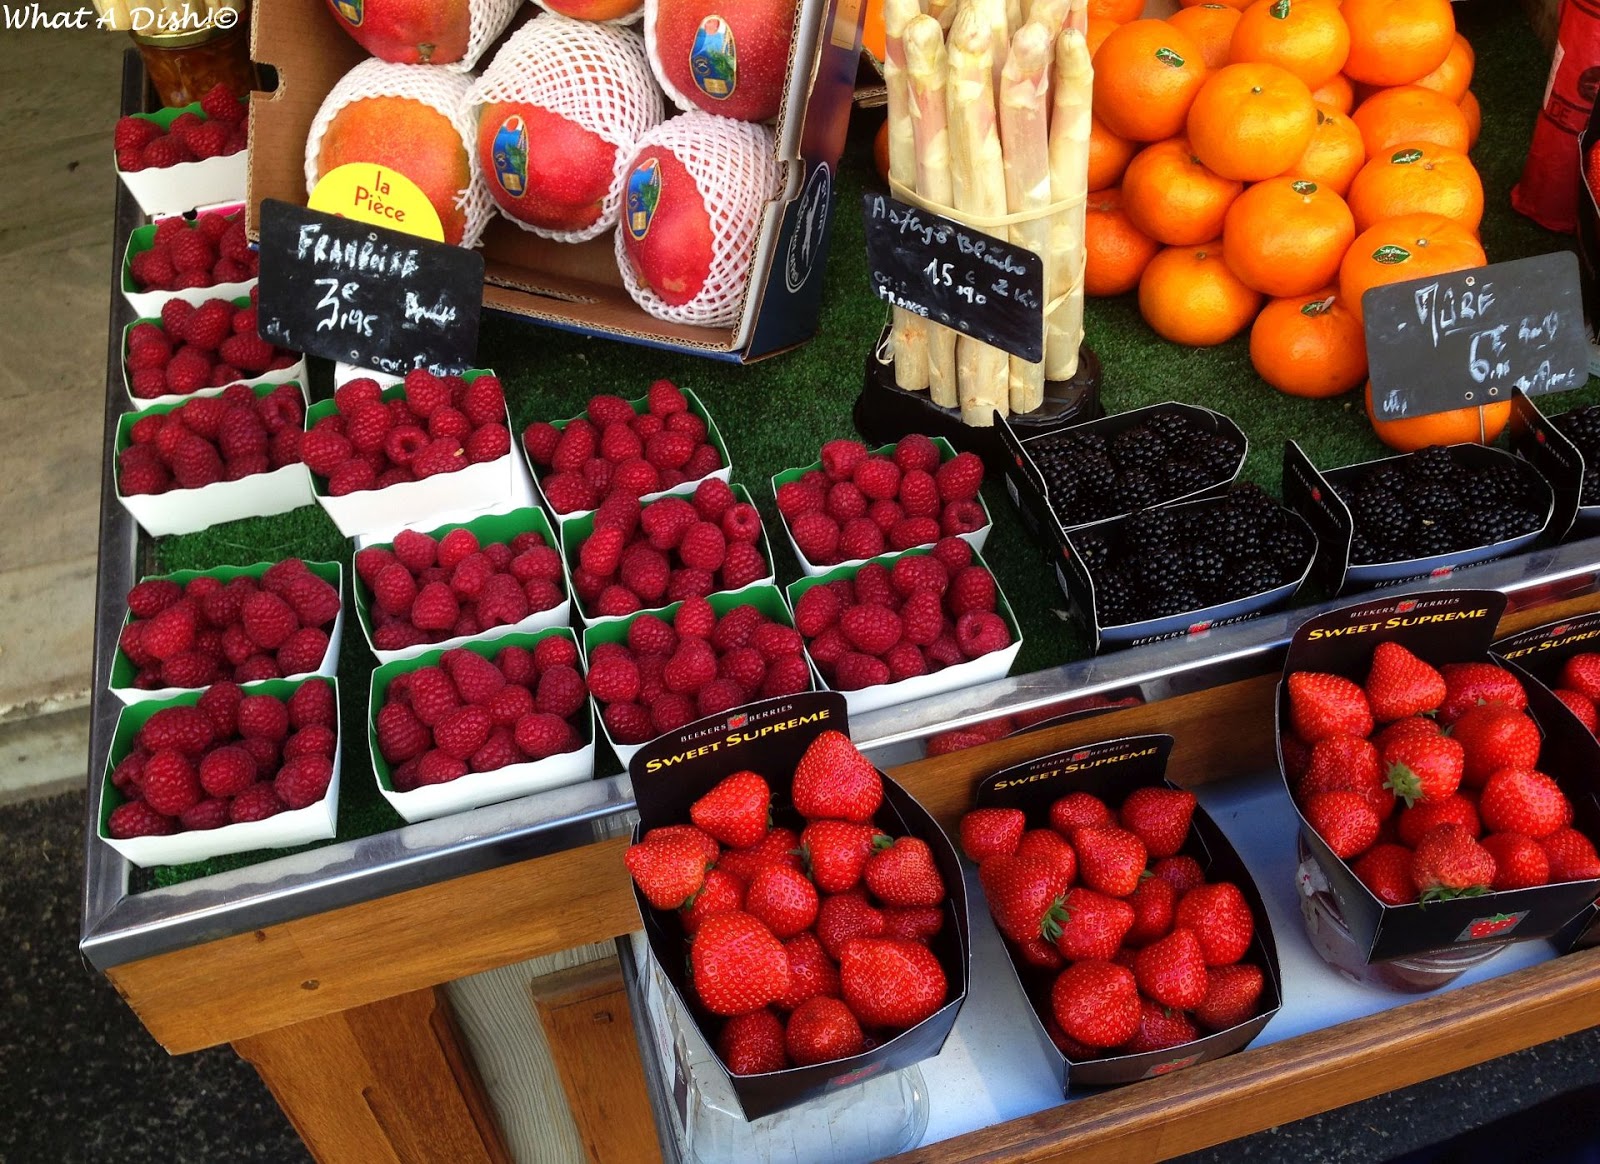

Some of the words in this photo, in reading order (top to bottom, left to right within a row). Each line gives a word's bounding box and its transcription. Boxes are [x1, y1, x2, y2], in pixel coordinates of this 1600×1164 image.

[375, 170, 390, 196] la
[354, 185, 405, 222] Pièce
[879, 285, 929, 317] FRANCE
[1307, 622, 1382, 641] SWEET
[1384, 608, 1488, 630] SUPREME
[1350, 606, 1395, 619] BEEKERS
[1416, 597, 1460, 609] BERRIES
[645, 741, 722, 773] SWEET
[726, 709, 830, 748] SUPREME
[681, 723, 727, 743] BEEKERS
[749, 704, 793, 722] BERRIES
[993, 769, 1061, 791] SWEET
[1064, 746, 1158, 774] SUPREME
